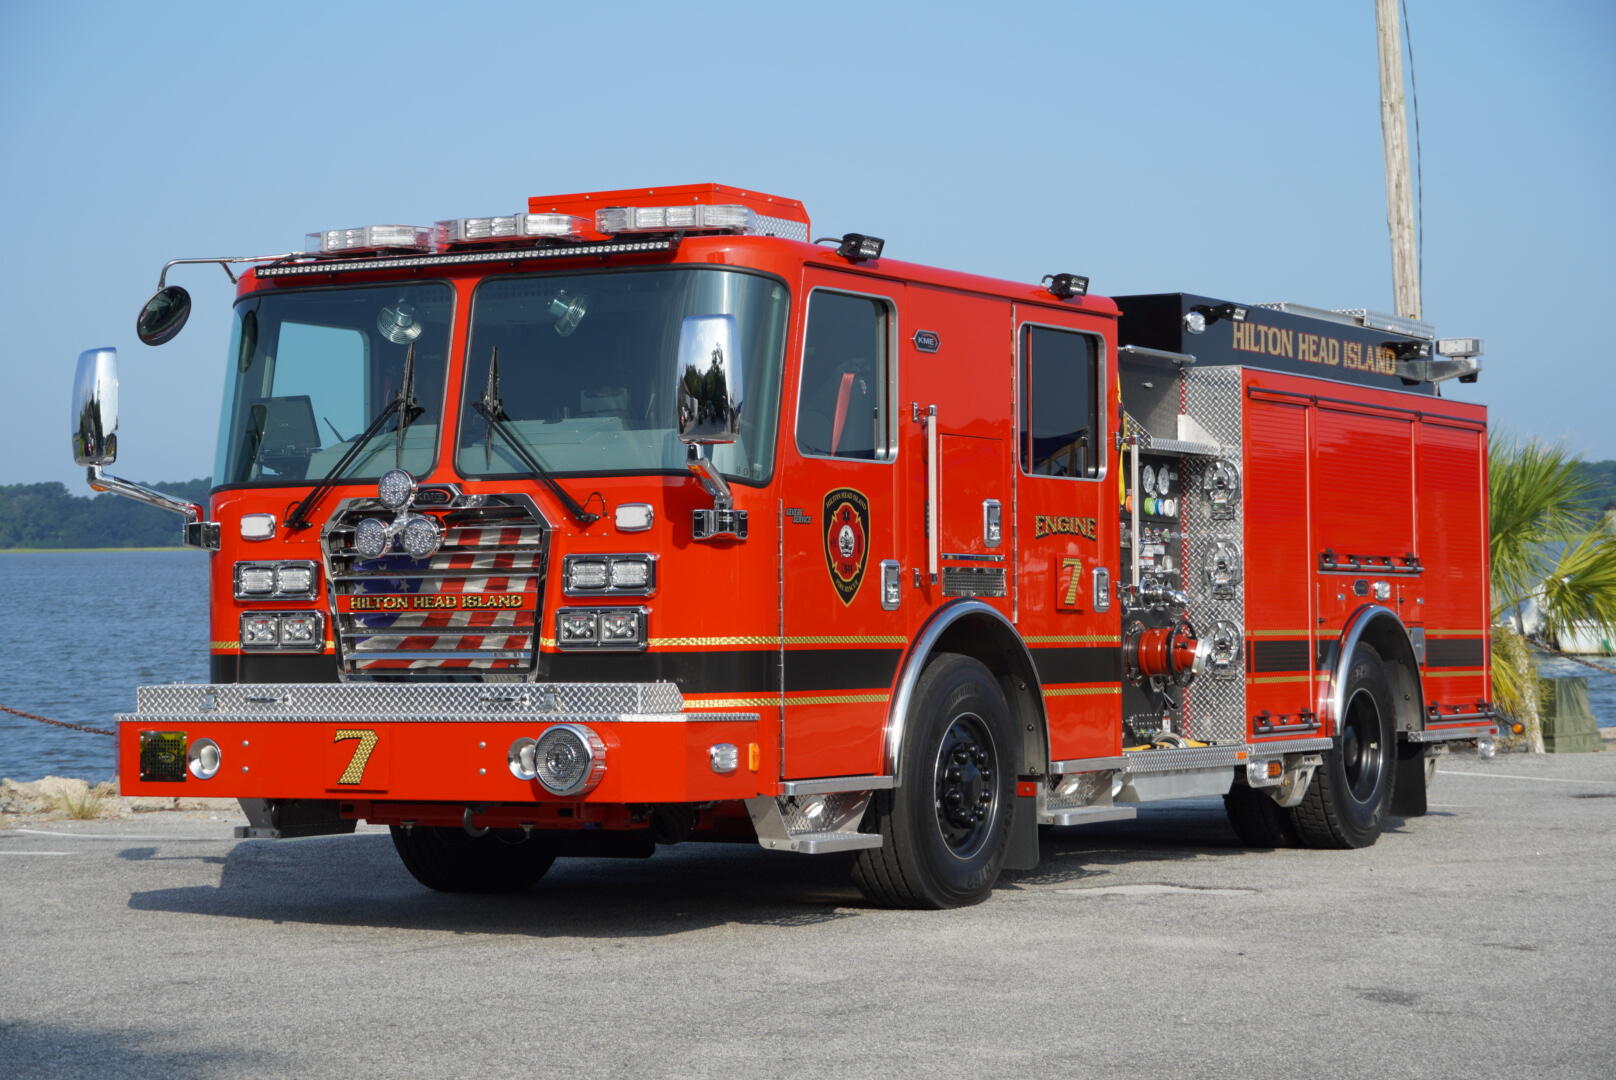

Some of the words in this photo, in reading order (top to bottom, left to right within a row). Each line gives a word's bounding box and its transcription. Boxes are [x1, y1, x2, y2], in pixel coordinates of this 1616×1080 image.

[917, 336, 935, 346] KME
[1232, 321, 1294, 358] HILTON
[1297, 333, 1340, 366] HEAD
[1342, 340, 1397, 376] ISLAND
[1035, 515, 1096, 541] ENGINE
[1062, 557, 1082, 605] 7
[350, 596, 408, 610] HILTON
[413, 595, 457, 609] HEAD
[461, 594, 523, 609] ISLAND
[333, 729, 379, 785] 7
